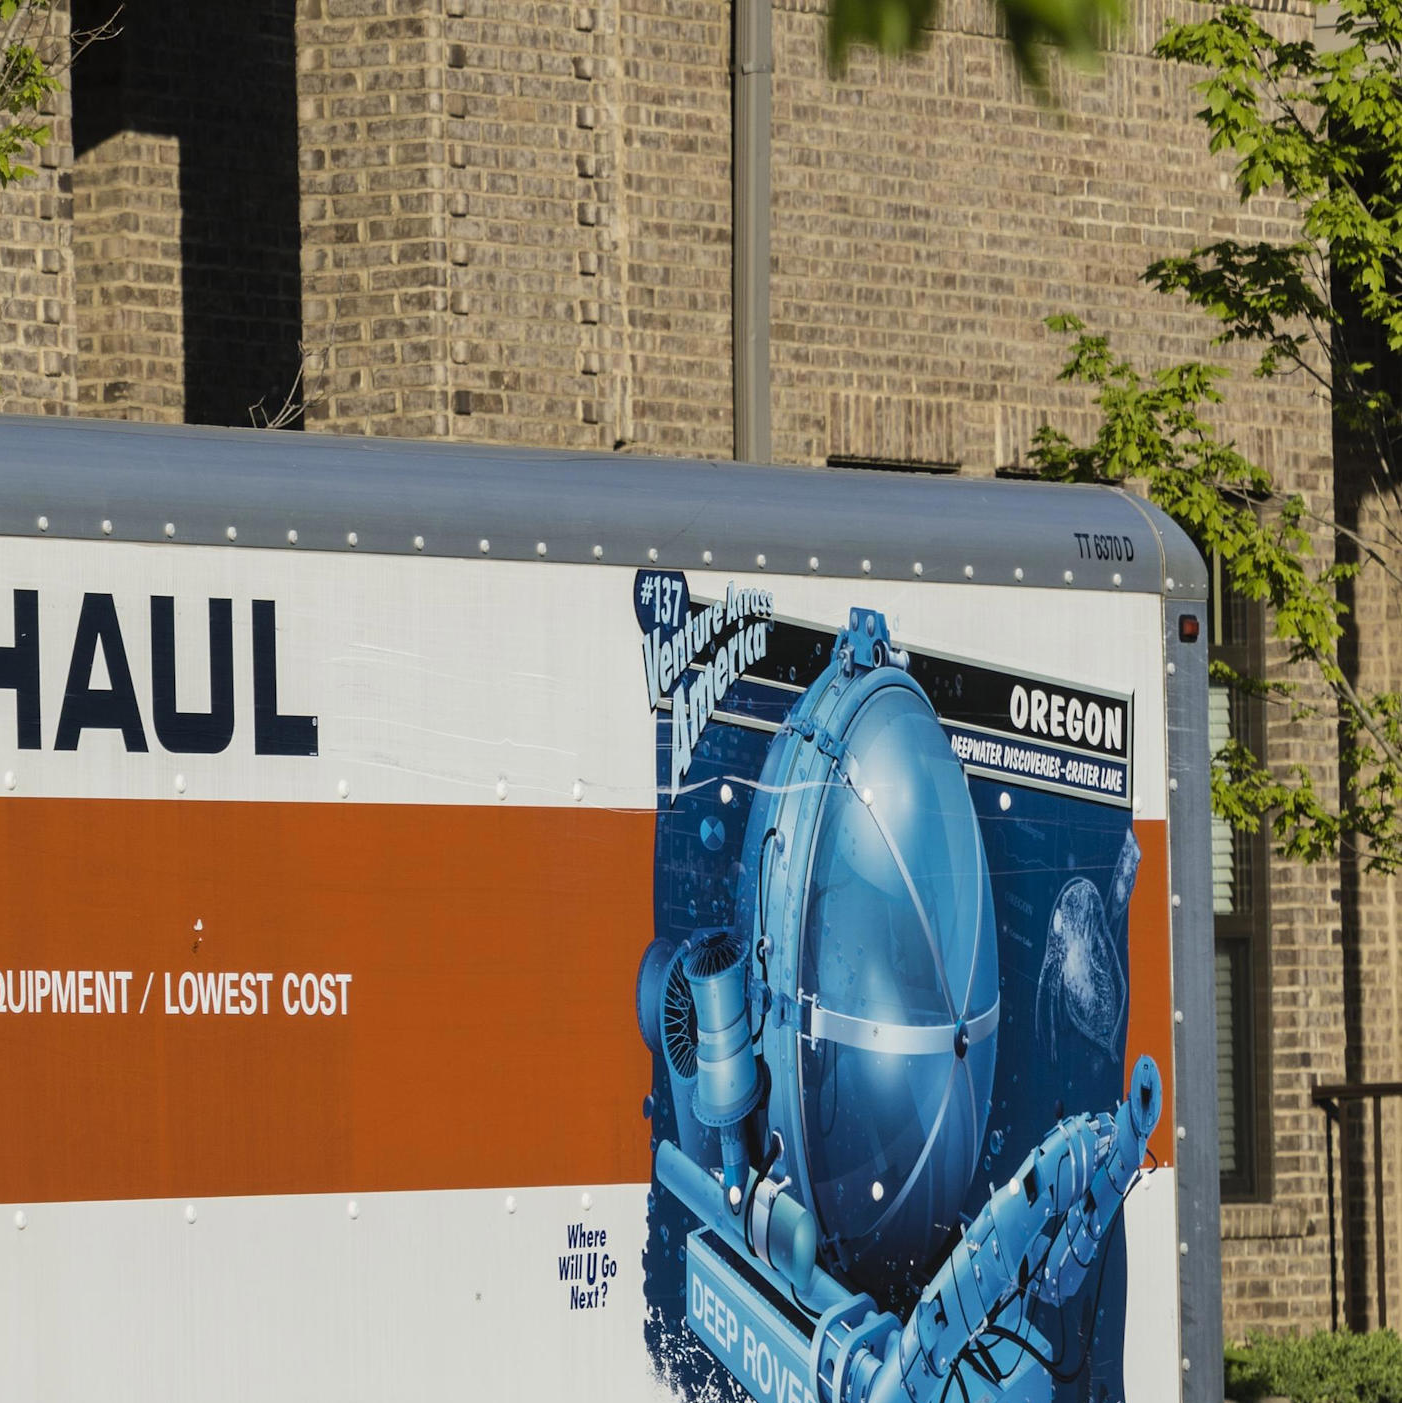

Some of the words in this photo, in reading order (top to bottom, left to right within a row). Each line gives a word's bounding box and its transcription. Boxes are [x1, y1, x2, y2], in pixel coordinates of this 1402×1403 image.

[1074, 532, 1095, 560] TT
[1096, 533, 1123, 561] 6370
[1123, 536, 1134, 562] D
[640, 575, 683, 627] #137
[643, 600, 724, 709] Venture
[726, 580, 774, 626] Across
[671, 618, 767, 804] America
[1010, 684, 1123, 750] OREGON
[951, 734, 1003, 767] DEEPWATER
[1100, 766, 1123, 792] LAKE
[164, 972, 274, 1016] LOWEST
[282, 973, 352, 1016] COST
[567, 1222, 606, 1250] Where
[558, 1254, 583, 1281] Will
[586, 1253, 597, 1285] U
[601, 1256, 617, 1279] Go
[692, 1273, 739, 1354] DEEP
